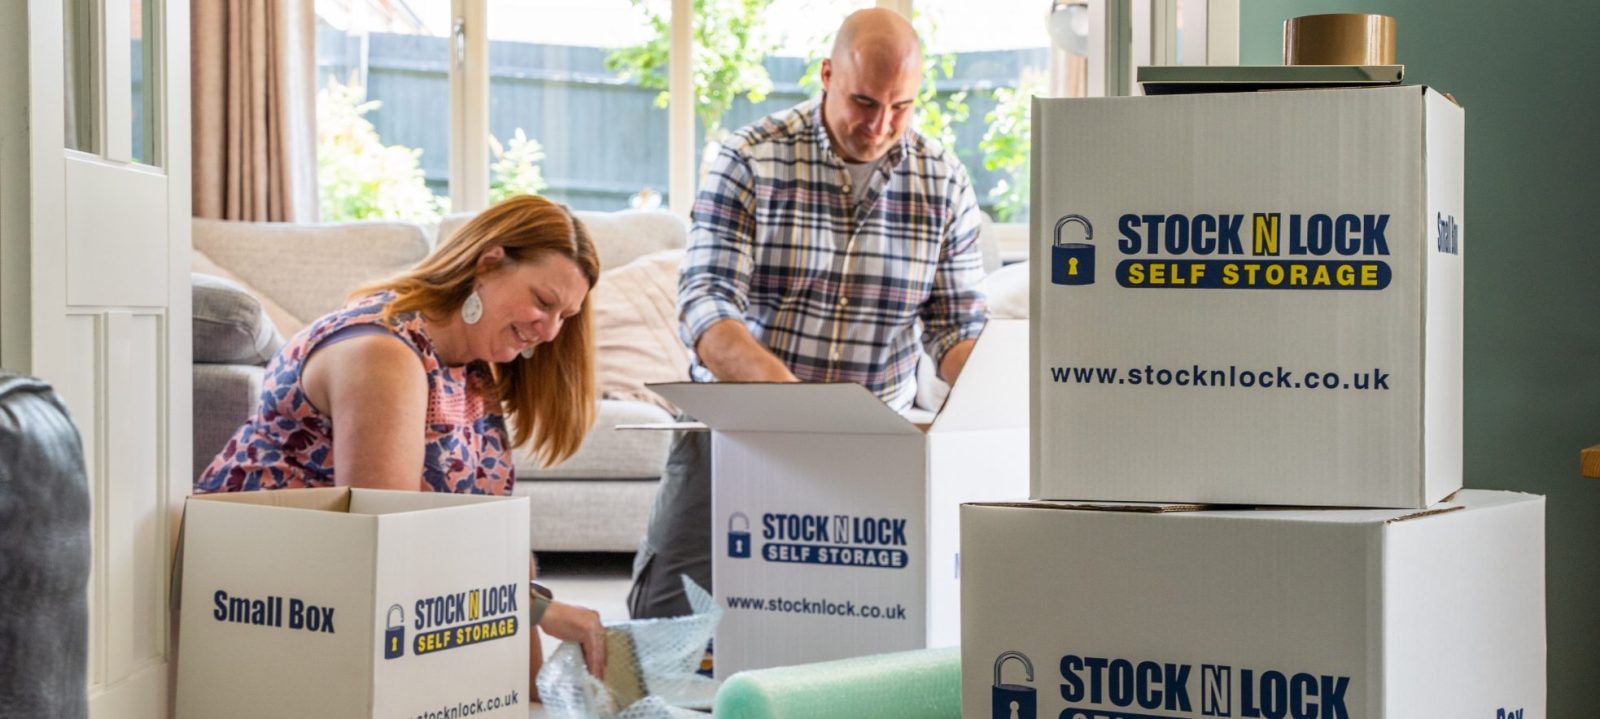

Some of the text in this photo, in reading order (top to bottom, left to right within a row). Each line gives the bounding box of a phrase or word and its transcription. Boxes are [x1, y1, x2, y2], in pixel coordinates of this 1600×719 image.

[1118, 213, 1391, 256] STOCK N LOCK
[1128, 264, 1379, 286] SELF STORAGE
[1051, 364, 1390, 391] www.stocknlock.co.uk
[762, 513, 907, 546] STOCK N LOCK
[768, 545, 902, 567] SELF STORAGE
[213, 590, 335, 634] Small Box
[415, 583, 518, 630] STOCK N LOCK
[726, 596, 907, 621] www.stocknlock.co.uk
[417, 621, 515, 652] SELF STORAGE
[1060, 655, 1350, 719] STOCK N LOCK
